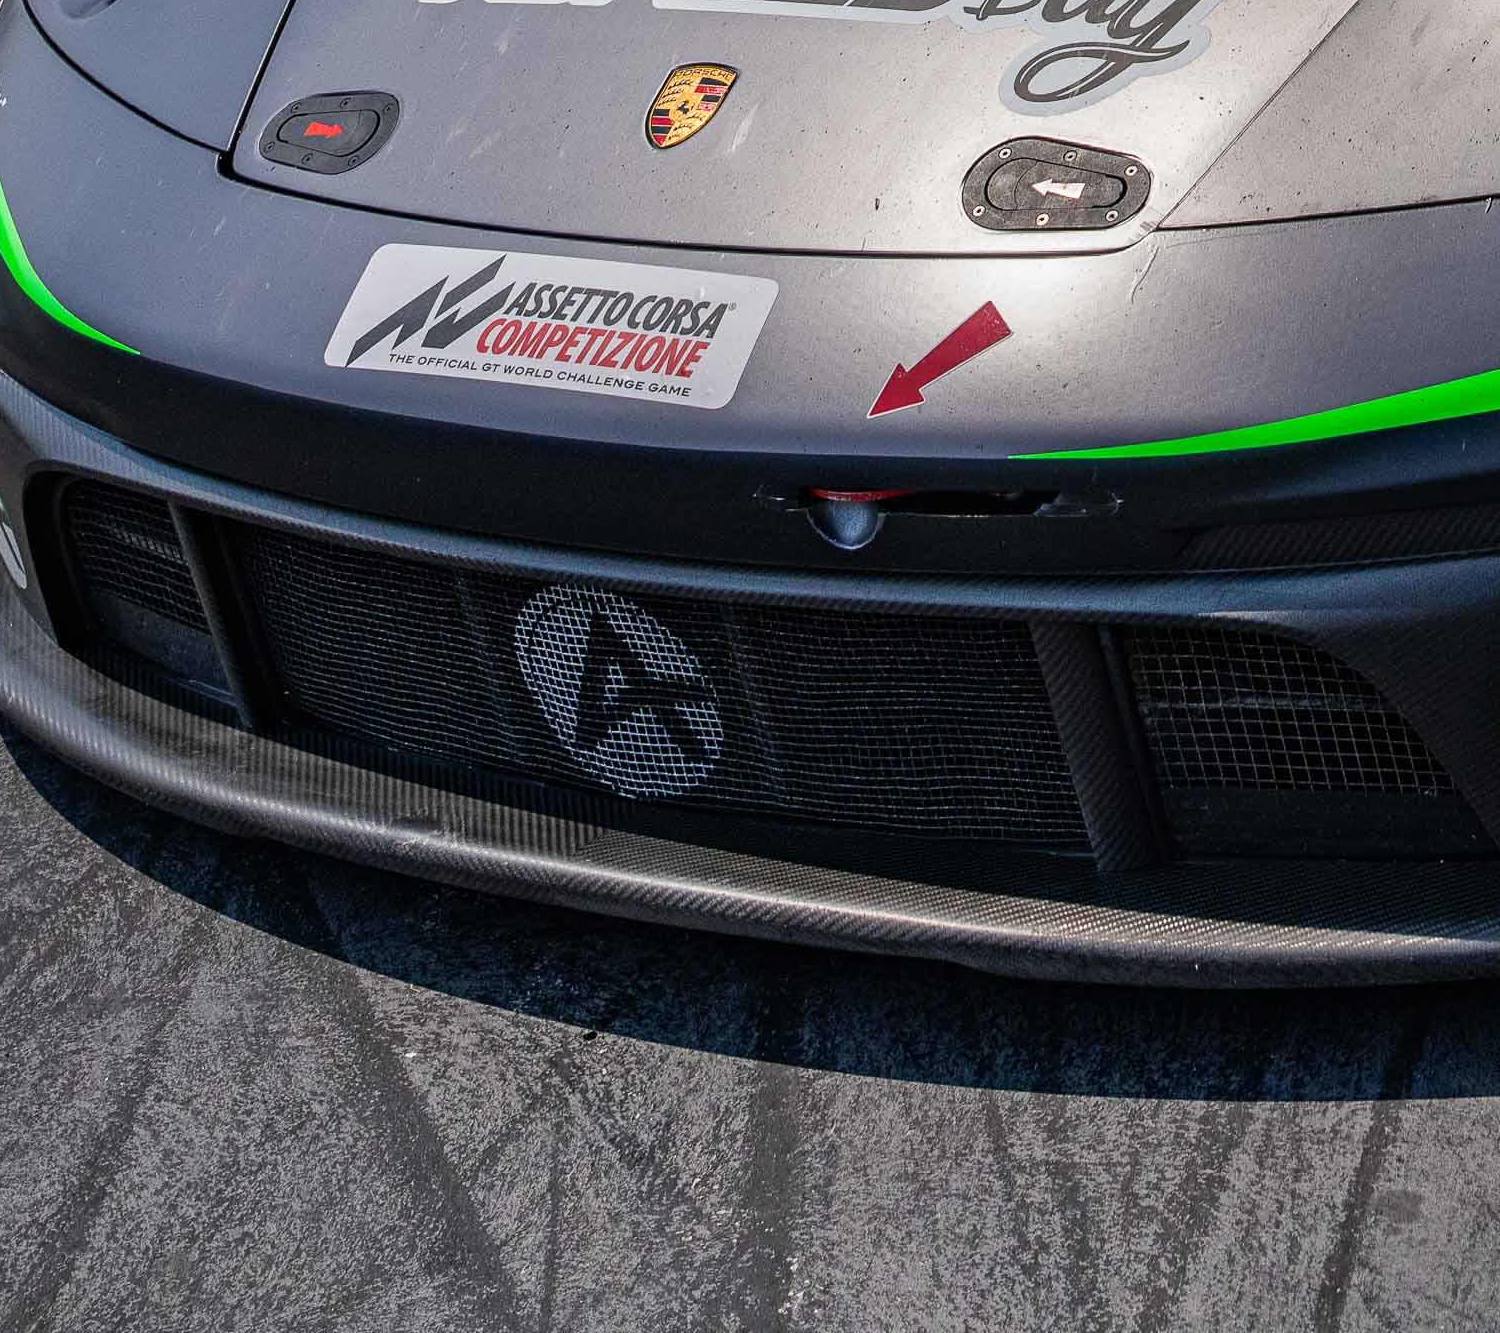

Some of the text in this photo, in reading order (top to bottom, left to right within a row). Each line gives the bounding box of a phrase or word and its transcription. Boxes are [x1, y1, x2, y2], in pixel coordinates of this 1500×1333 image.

[672, 68, 735, 82] PORSCHE
[476, 317, 710, 380] COMPETIZIONE
[389, 352, 693, 398] THE OFFICIAL GT WORLD CHALLENGE GAME
